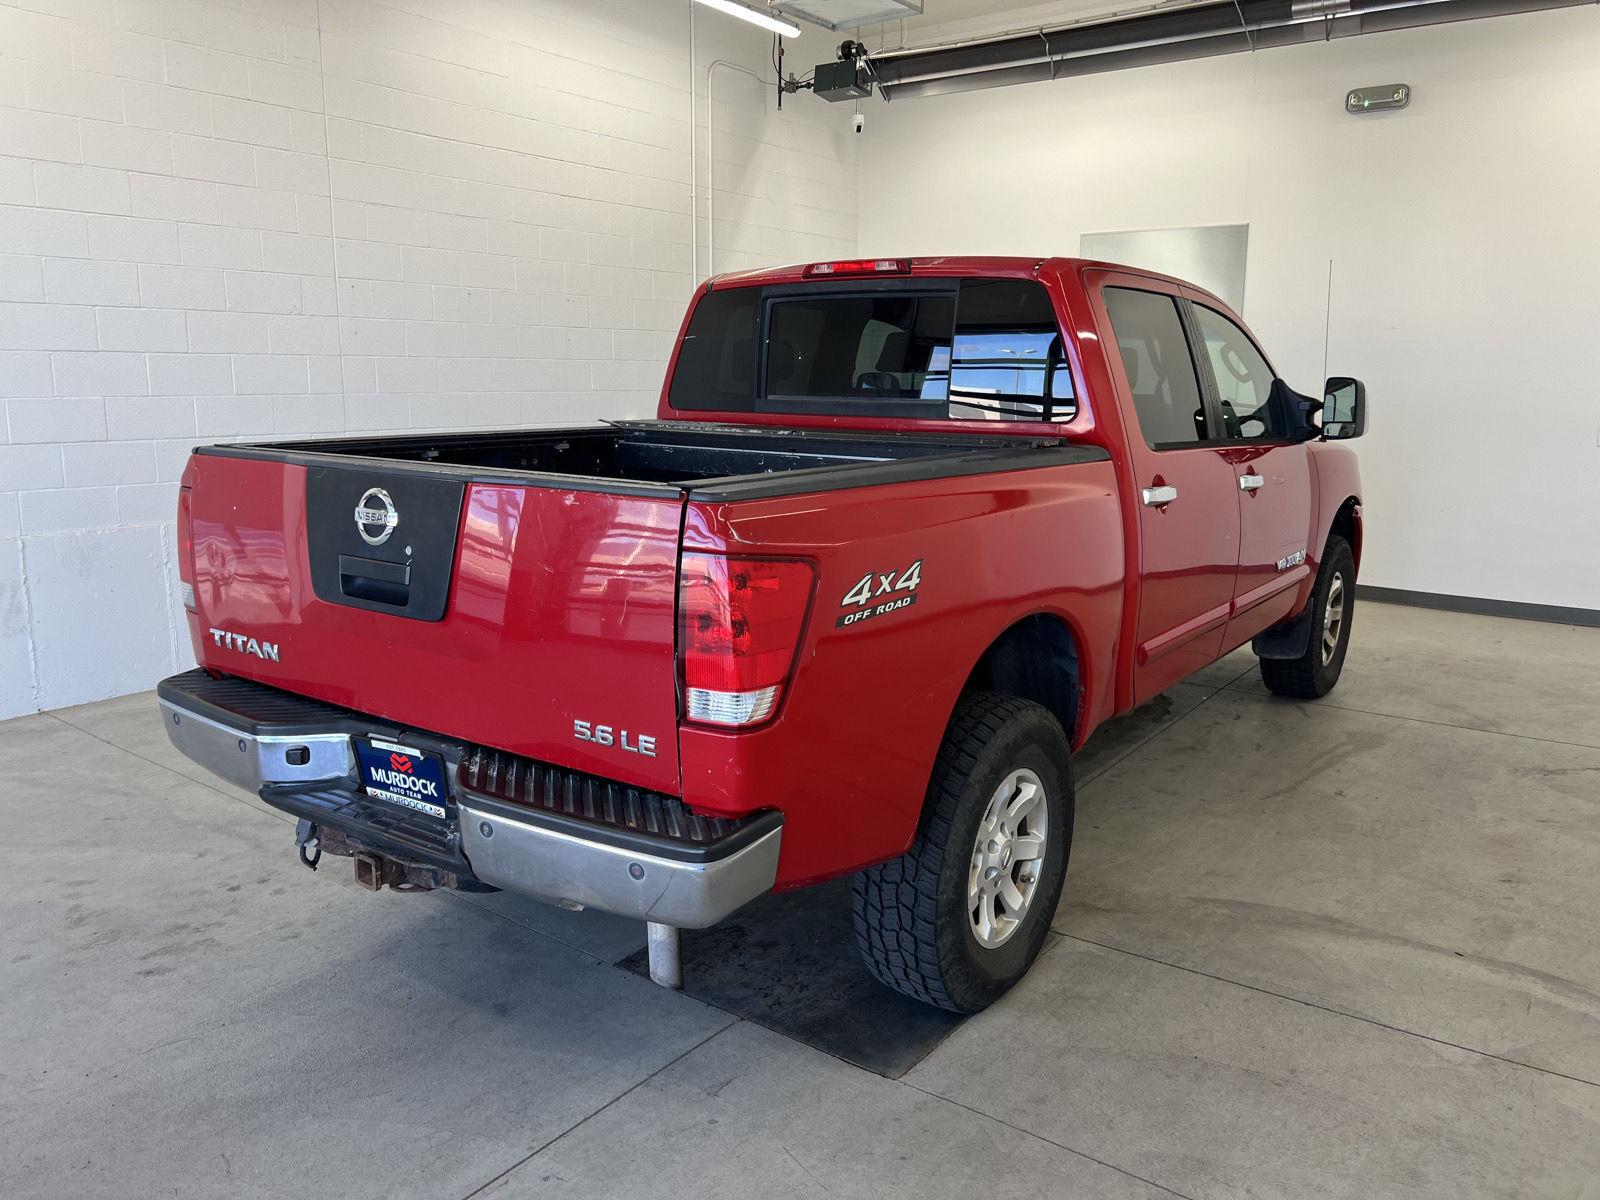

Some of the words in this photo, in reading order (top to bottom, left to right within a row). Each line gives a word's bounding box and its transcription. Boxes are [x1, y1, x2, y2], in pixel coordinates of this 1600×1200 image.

[357, 510, 389, 523] NISSAN
[844, 609, 872, 625] OFF
[876, 597, 911, 615] ROAD
[209, 627, 280, 663] TITAN
[574, 719, 614, 747] 5.6
[620, 730, 656, 758] LE
[370, 766, 438, 797] MURDOCK
[389, 786, 405, 795] AUTO
[406, 790, 422, 800] TEAM
[385, 794, 430, 812] MURDOCK
